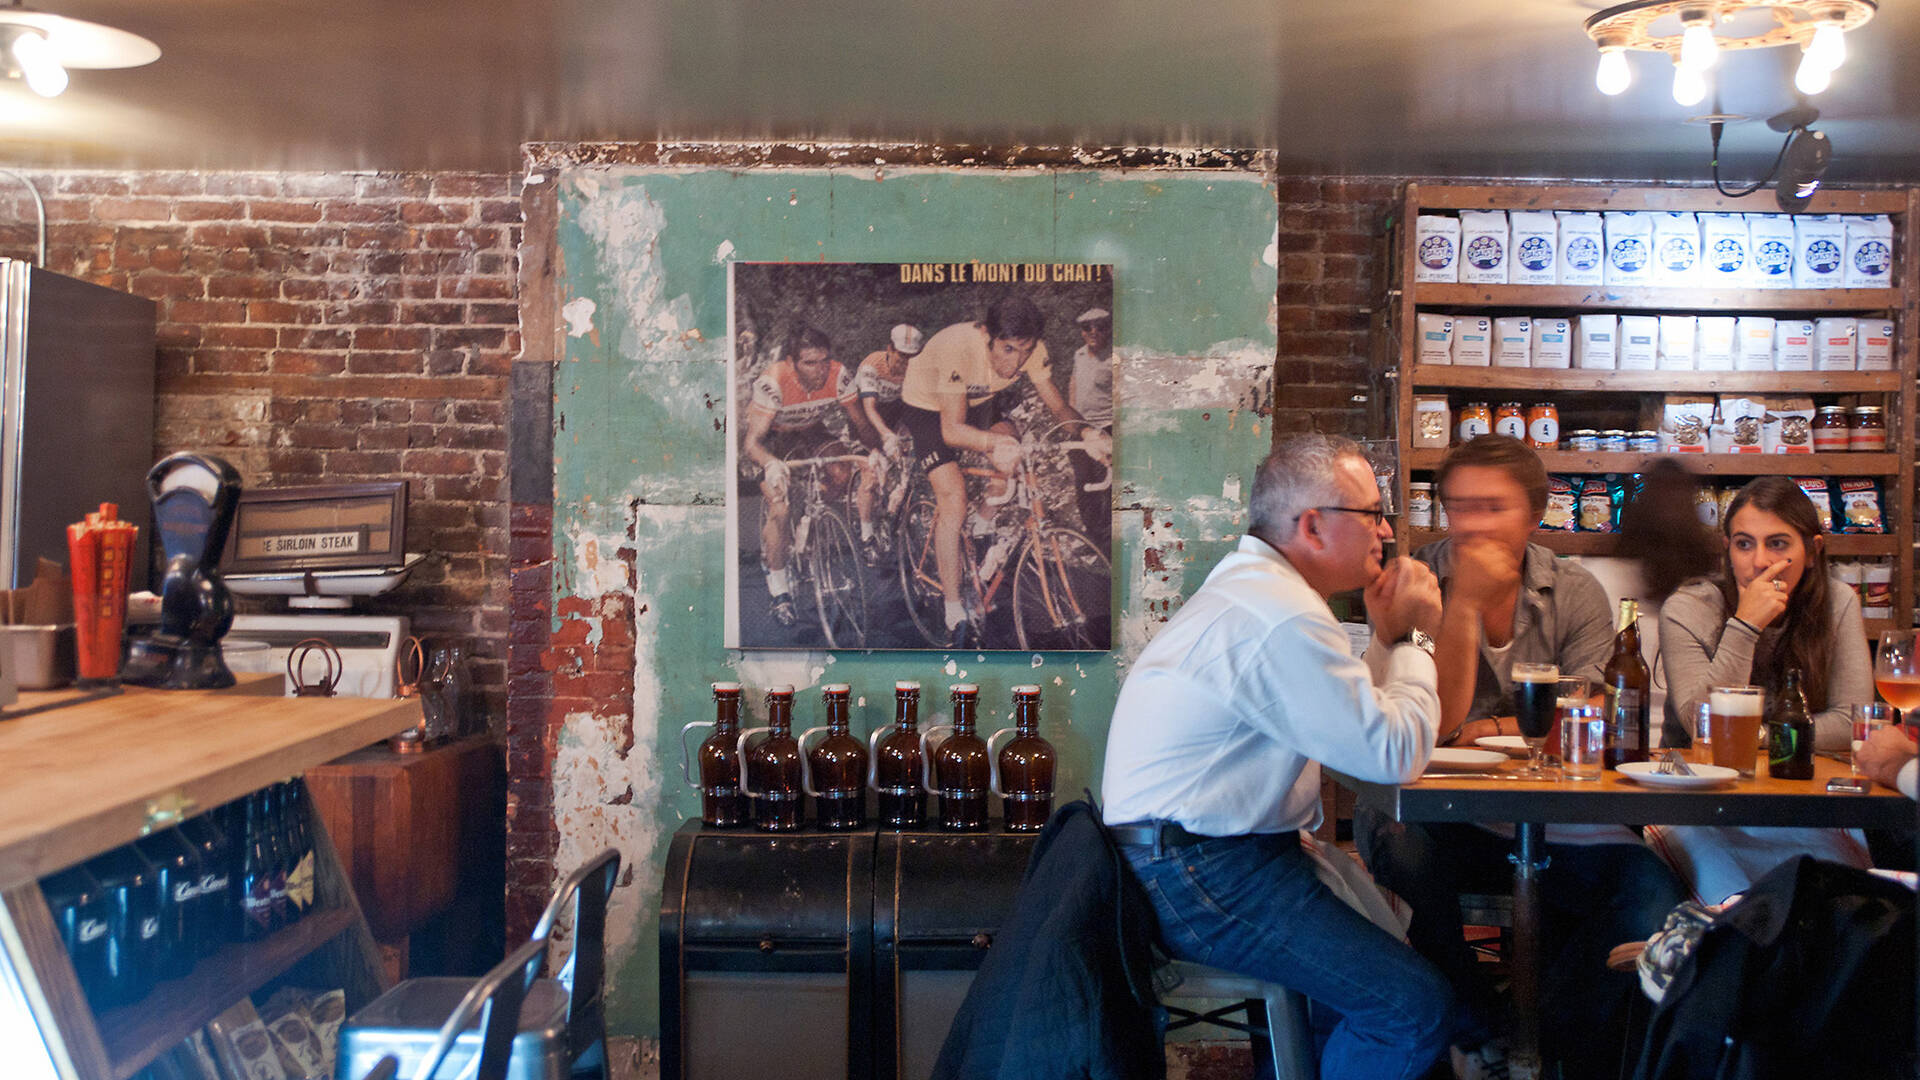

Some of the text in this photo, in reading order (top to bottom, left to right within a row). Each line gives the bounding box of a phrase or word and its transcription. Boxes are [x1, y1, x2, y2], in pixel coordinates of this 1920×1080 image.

[900, 264, 945, 283] DANS
[951, 264, 966, 283] LE
[972, 264, 1019, 282] MONT
[1024, 264, 1046, 282] DU
[276, 538, 316, 551] SIRLOIN
[321, 535, 354, 549] STEAK
